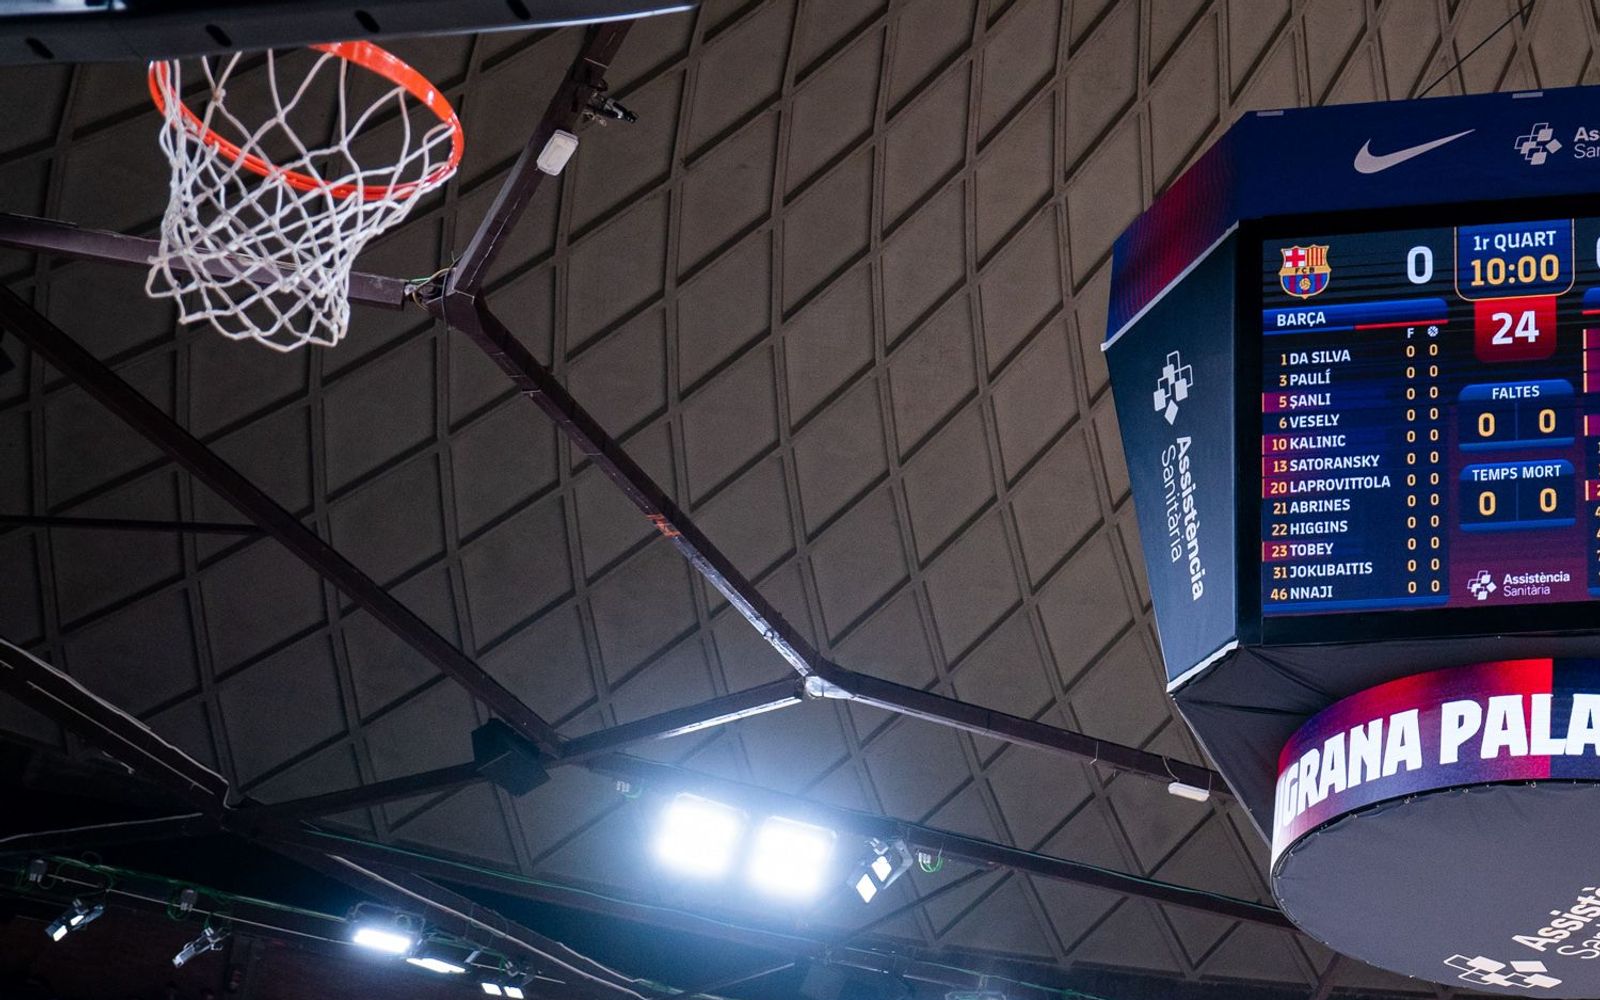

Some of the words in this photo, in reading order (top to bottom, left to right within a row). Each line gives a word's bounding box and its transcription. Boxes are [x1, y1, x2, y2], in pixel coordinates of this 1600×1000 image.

[1474, 236, 1489, 250] 1r
[1494, 231, 1556, 252] QUART
[1407, 246, 1433, 283] 0
[1471, 255, 1558, 286] 10:00
[1277, 312, 1325, 326] BARÇA
[1493, 311, 1539, 344] 24
[1408, 328, 1414, 338] F
[1282, 354, 1286, 365] 1
[1290, 353, 1308, 364] DA
[1312, 350, 1350, 363] SILVA
[1407, 346, 1414, 357] 0
[1430, 344, 1437, 355] 0
[1280, 375, 1287, 386] 3
[1290, 369, 1330, 385] PAULÍ
[1407, 367, 1414, 378] 0
[1280, 396, 1286, 407] 5
[1290, 393, 1330, 409] ŞANLI
[1407, 388, 1415, 399] 0
[1493, 385, 1539, 399] FALTES
[1280, 418, 1287, 428] 6
[1290, 414, 1339, 428] VESELY
[1407, 410, 1415, 421] 0
[1479, 413, 1494, 436] 0
[1540, 409, 1555, 432] 0
[1273, 439, 1286, 450] 10
[1290, 435, 1345, 449] KALINIC
[1407, 431, 1415, 442] 0
[1274, 461, 1287, 472] 13
[1290, 455, 1379, 471] SATORANSKY
[1407, 453, 1415, 464] 0
[1472, 468, 1517, 481] TEMPS
[1523, 465, 1561, 478] MORT
[1271, 482, 1287, 493] 20
[1290, 476, 1390, 492] LAPROVITTOLA
[1408, 474, 1415, 486] 0
[1162, 445, 1184, 562] Sanitària
[1274, 503, 1286, 514] 21
[1290, 499, 1350, 513] ABRINES
[1408, 495, 1415, 506] 0
[1480, 492, 1495, 515] 0
[1541, 488, 1556, 512] 0
[1176, 436, 1206, 600] Assistència
[1272, 524, 1287, 536] 22
[1291, 521, 1347, 535] HIGGINS
[1408, 517, 1416, 528] 0
[1272, 545, 1287, 557] 23
[1290, 543, 1333, 556] TOBEY
[1408, 538, 1416, 550] 0
[1274, 567, 1287, 578] 31
[1290, 562, 1372, 578] JOKUBAITIS
[1408, 560, 1416, 571] 0
[1503, 571, 1570, 584] Assistència
[1271, 589, 1287, 600] 46
[1291, 586, 1332, 599] NNAJI
[1408, 582, 1416, 593] 0
[1504, 586, 1550, 596] Sanitària
[1274, 709, 1422, 838] GRANA
